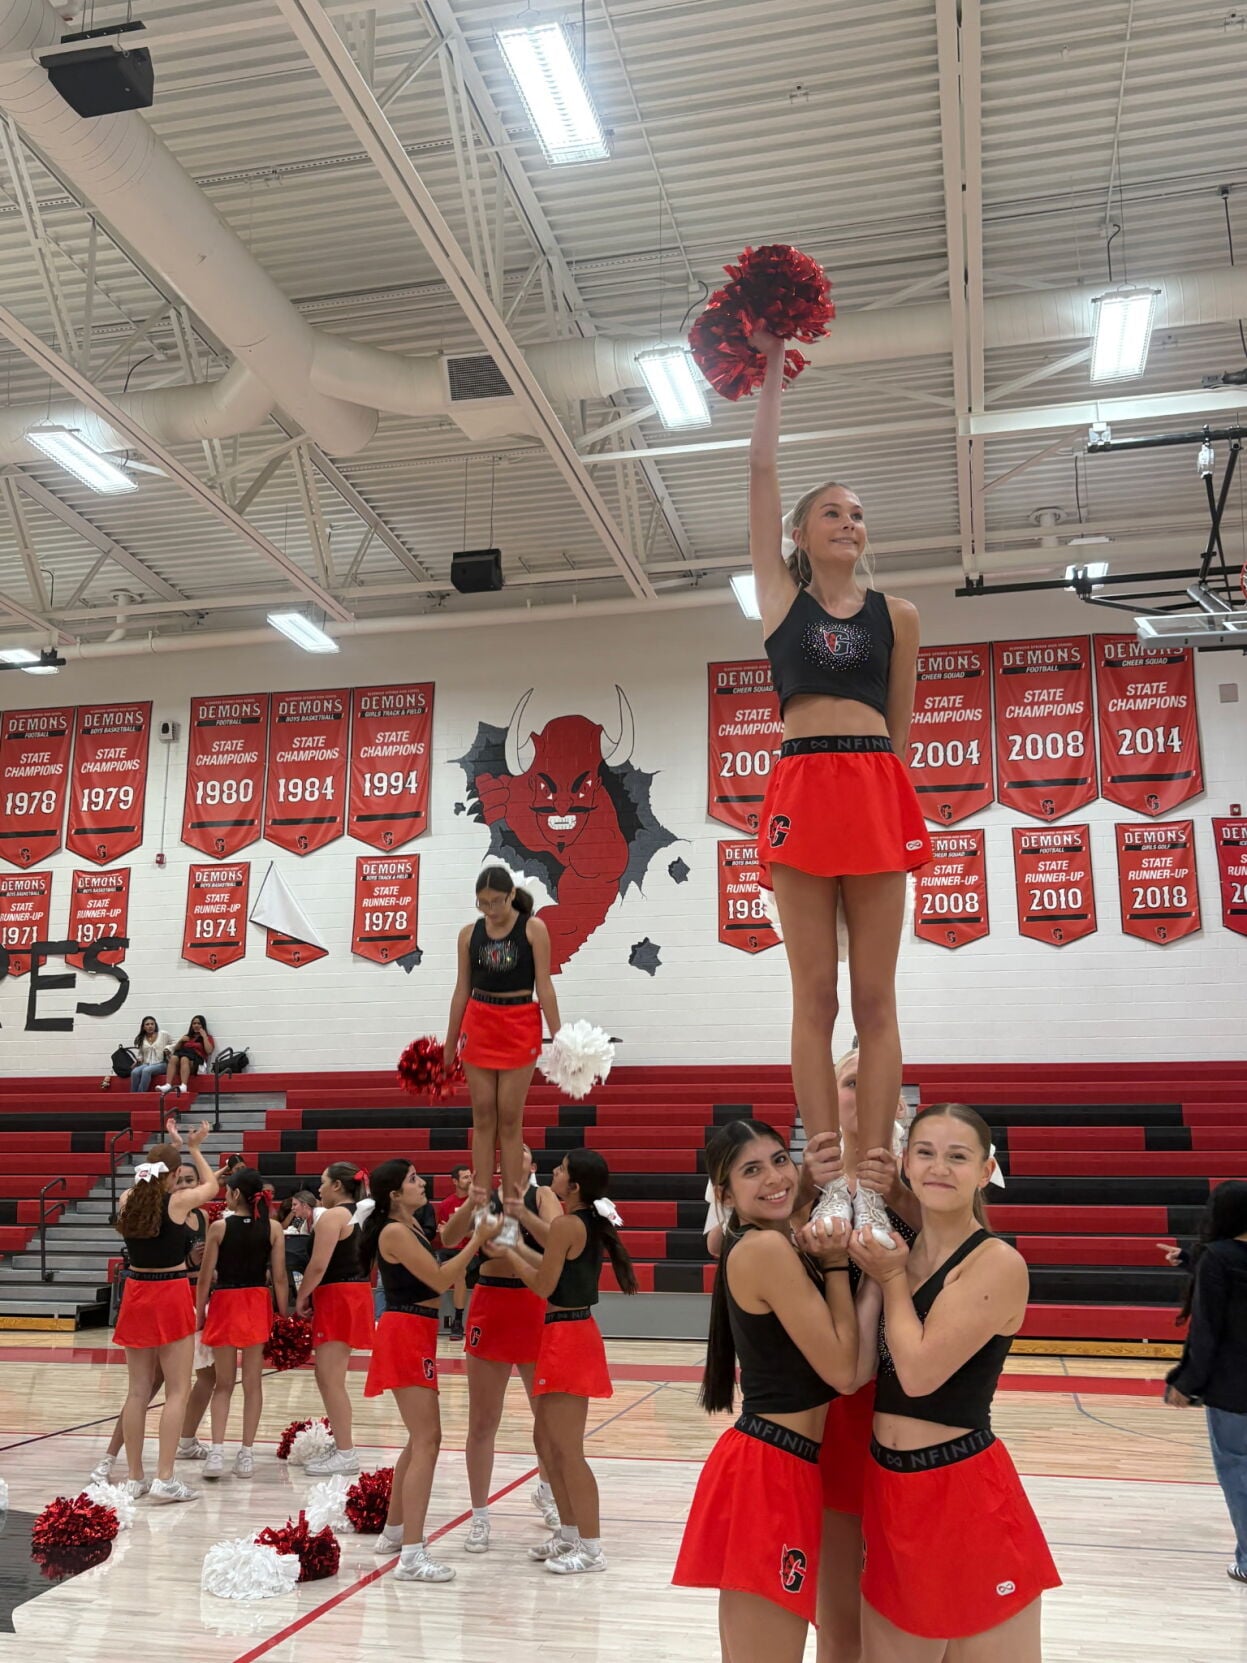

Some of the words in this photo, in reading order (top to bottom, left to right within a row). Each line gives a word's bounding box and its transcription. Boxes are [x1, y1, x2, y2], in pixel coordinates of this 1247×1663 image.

[917, 655, 981, 672] EMONS
[1003, 648, 1081, 666] DEMONS
[1122, 658, 1144, 667] CHEER
[1145, 657, 1168, 665] SQUAD
[943, 671, 965, 679] SQUAD
[1026, 665, 1059, 673] FOOTBALL
[718, 670, 771, 687] DEMO
[1024, 688, 1064, 702] STATE
[1126, 682, 1167, 696] STATE
[278, 699, 343, 715] DEMONS
[361, 693, 426, 710] DEMONS
[924, 695, 964, 709] STATE
[1108, 695, 1187, 712] CHAMPIONS
[199, 703, 261, 719] DEMONS
[735, 708, 772, 721] STATE
[911, 709, 982, 724] HAMPIONS
[1005, 701, 1084, 719] CHAMPIONS
[9, 716, 67, 732] DEMONS
[84, 711, 144, 727] DEMONS
[292, 736, 326, 748] STATE
[375, 731, 410, 744] STATE
[837, 738, 891, 750] NFINI
[1117, 726, 1183, 756] 2014
[212, 740, 244, 752] STATE
[360, 743, 424, 758] CHAMPIONS
[1008, 730, 1085, 761] 2008
[20, 752, 51, 764] STATE
[95, 747, 127, 760] STATE
[196, 751, 258, 766] CHAMPIONS
[276, 748, 339, 763] CHAMPIONS
[910, 739, 980, 768] 2004
[4, 763, 64, 777] CHAMPIONS
[81, 759, 140, 773] CHAMPIONS
[278, 775, 335, 803] 1984
[363, 770, 418, 797] 1994
[81, 786, 134, 811] 1979
[195, 778, 254, 805] 1980
[5, 790, 57, 815] 1978
[1021, 834, 1082, 848] DEMONS
[1124, 830, 1186, 844] DEMONS
[931, 839, 977, 851] MONS
[363, 863, 412, 875] DEMONS
[934, 864, 964, 875] STATE
[1037, 860, 1069, 871] STATE
[1141, 857, 1173, 868] STATE
[78, 876, 123, 888] DEMONS
[195, 871, 243, 882] DEMONS
[921, 875, 979, 887] RUNNER-UP
[1025, 871, 1085, 883] RUNNER-UP
[1128, 869, 1189, 881] RUNNER-UP
[1, 879, 45, 891] DEMONS
[373, 886, 400, 896] STATE
[87, 899, 110, 908] STATE
[205, 893, 230, 903] STATE
[362, 896, 412, 906] RUNNER-UP
[922, 892, 979, 915] 2008
[1029, 887, 1082, 911] 2010
[1132, 885, 1188, 909] 2018
[10, 902, 35, 911] STATE
[76, 908, 121, 919] RUNNER-UP
[194, 904, 241, 914] RUNNER-UP
[728, 899, 764, 920] 198
[0, 911, 44, 921] RUNNER-UP
[364, 911, 408, 932] 1978
[195, 918, 237, 938] 1974
[2, 926, 38, 945] 1971
[0, 937, 129, 1031] ES
